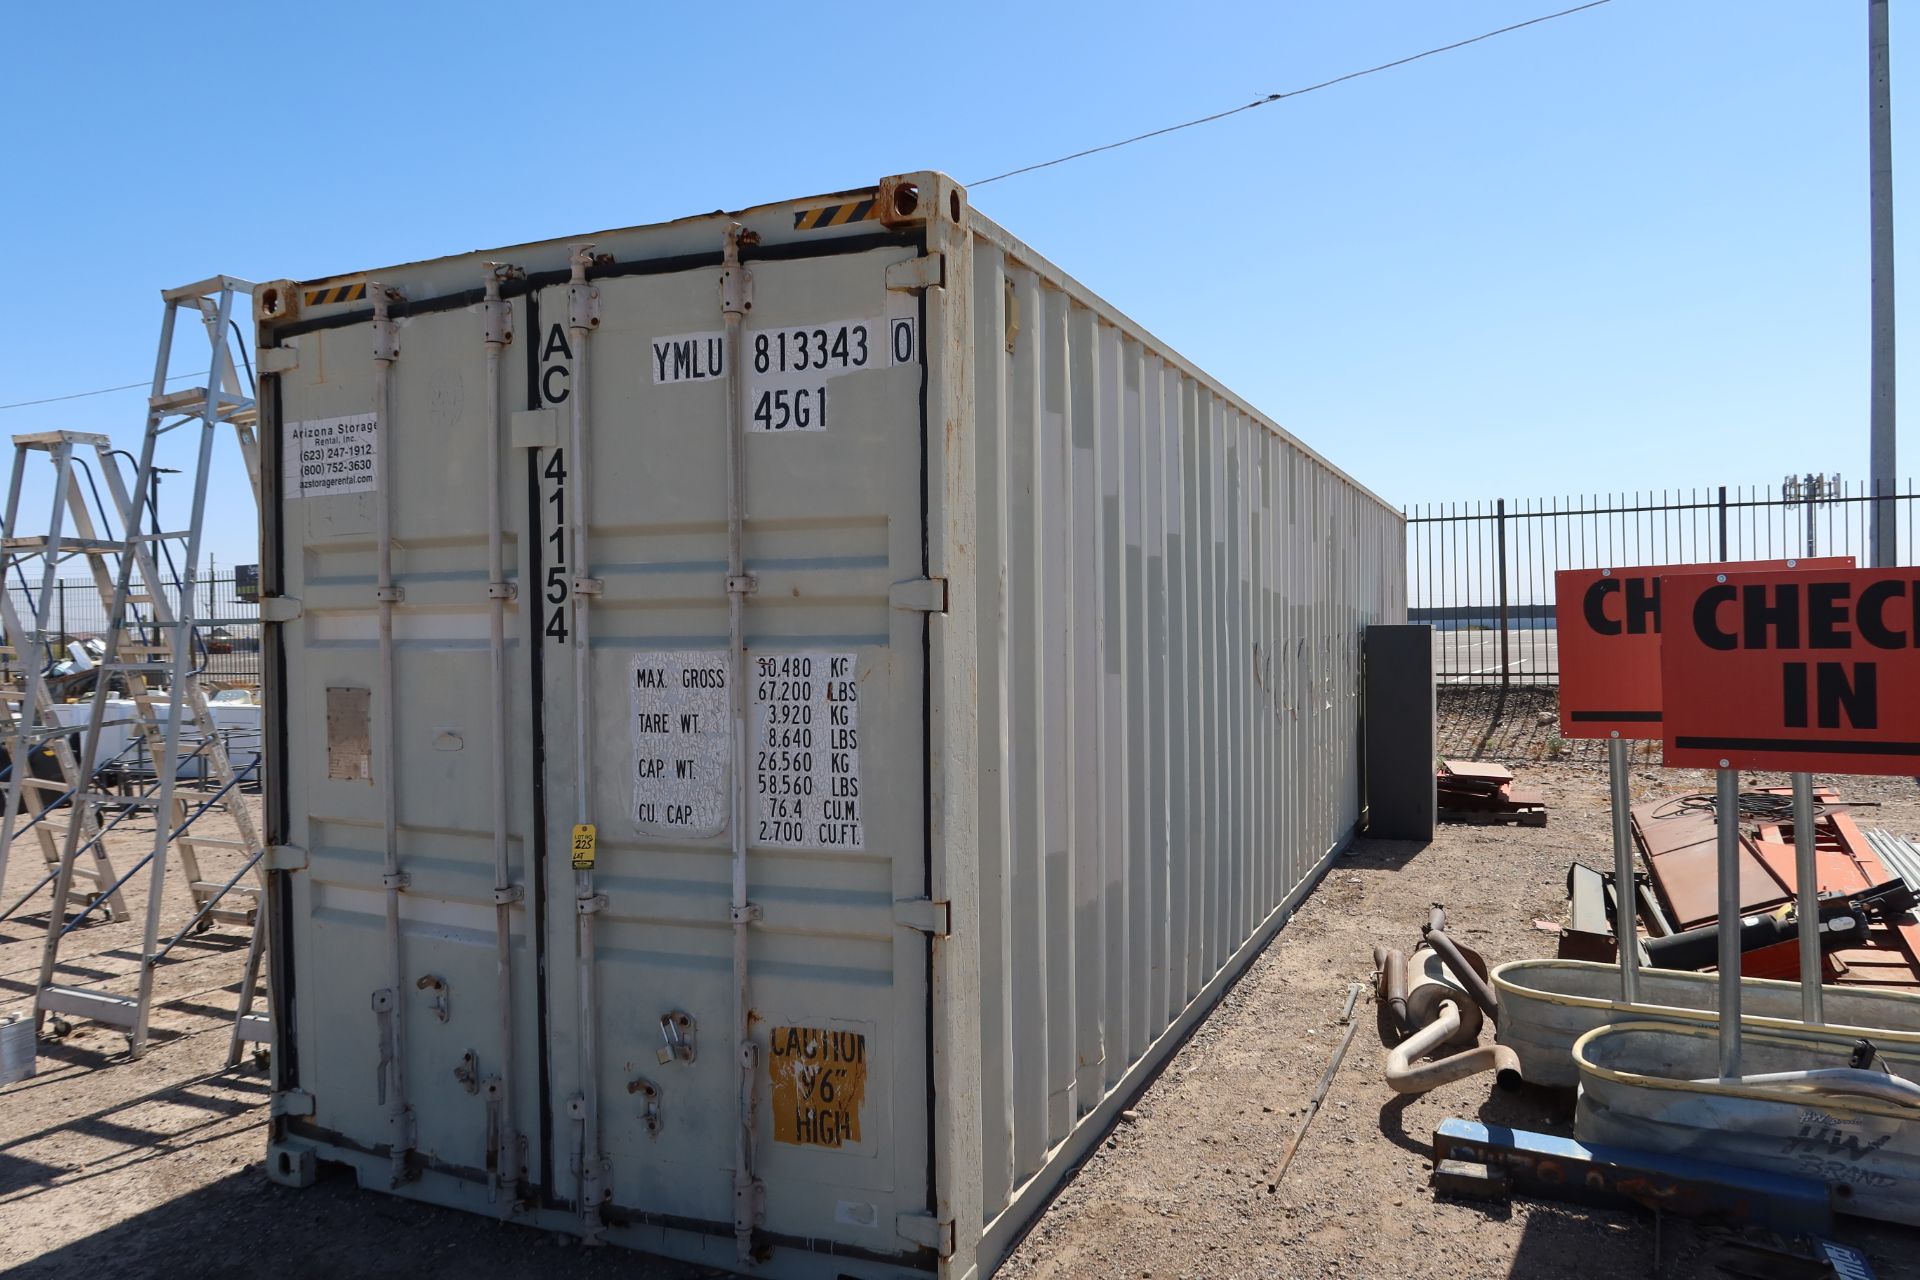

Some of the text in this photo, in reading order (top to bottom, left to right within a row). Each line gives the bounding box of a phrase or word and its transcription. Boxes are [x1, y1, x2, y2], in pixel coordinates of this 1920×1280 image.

[653, 321, 912, 381] YMLU 813343 0
[754, 387, 826, 430] 45G1
[292, 427, 333, 439] Arizona
[300, 444, 372, 463] (623) 247-1912
[300, 459, 372, 477] (800) 752-3630
[299, 475, 373, 488] azstoragerental.com
[544, 448, 569, 644] 41154
[1692, 579, 1920, 651] CHEC
[758, 657, 811, 678] 30,480
[637, 668, 725, 689] MAX. GROSS
[758, 681, 857, 702] 67,200 LBS
[1782, 661, 1878, 730] IN
[638, 713, 701, 734] TARE WT.
[768, 704, 849, 725] 3,920 KG
[768, 728, 857, 749] 8,640 LBS
[638, 759, 696, 780] CAP. WT.
[758, 751, 849, 773] 26,560 KG
[758, 774, 858, 797] 58,560 LBS
[638, 803, 693, 825] CU. CAP.
[769, 797, 859, 821] 76.4 CU.M.
[759, 821, 860, 845] 2,700 CU.FT.
[796, 1105, 852, 1146] HIGH
